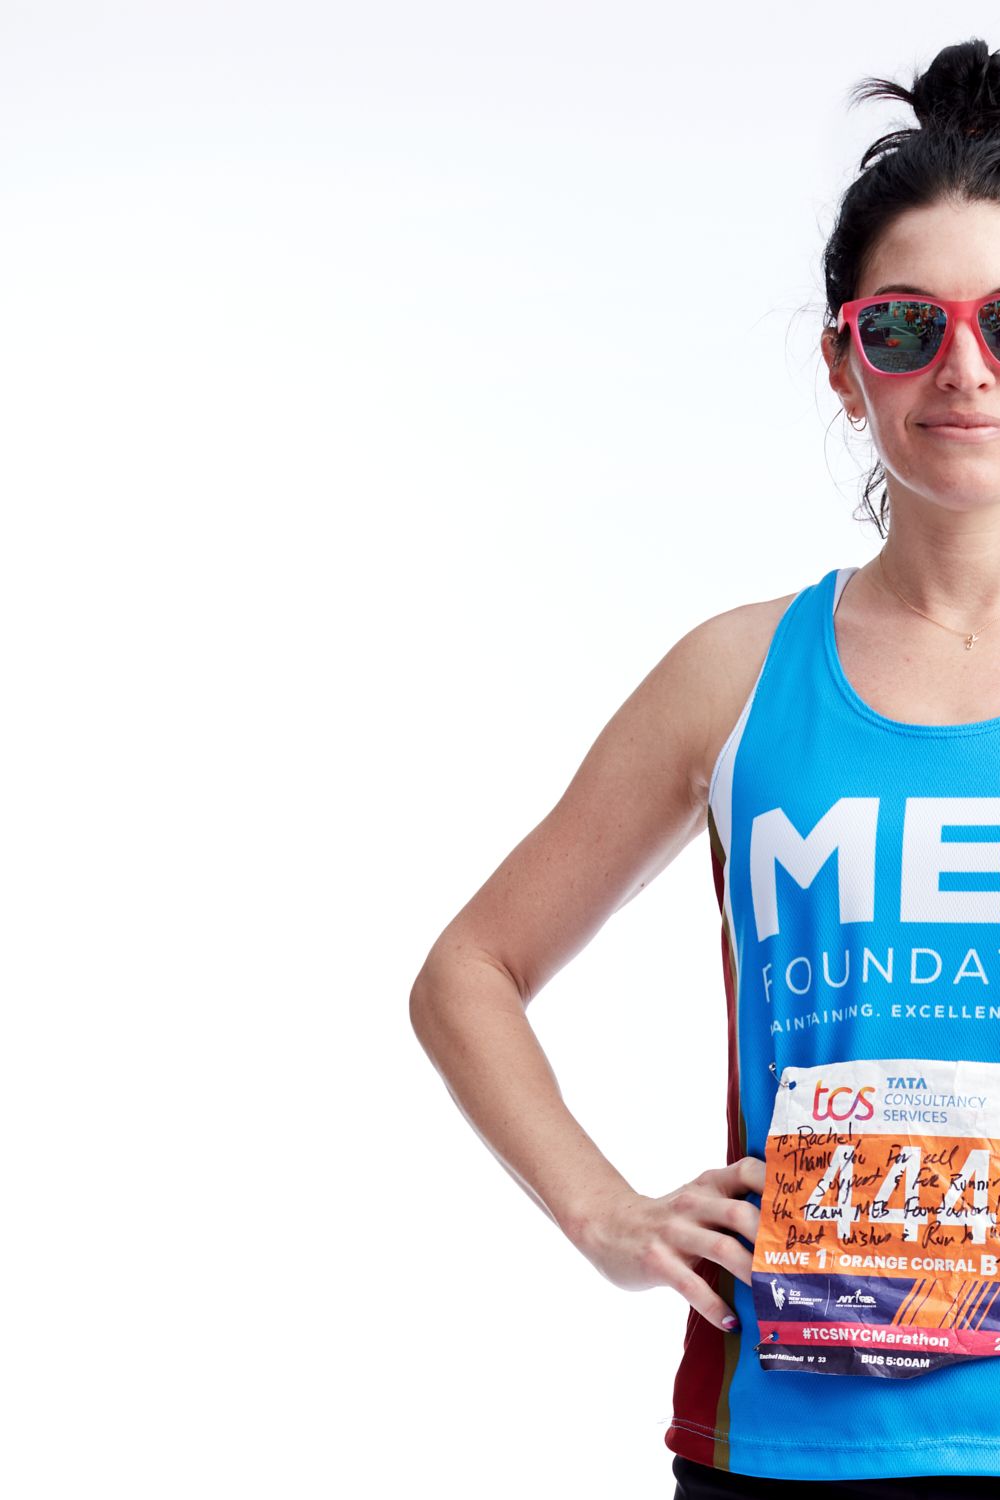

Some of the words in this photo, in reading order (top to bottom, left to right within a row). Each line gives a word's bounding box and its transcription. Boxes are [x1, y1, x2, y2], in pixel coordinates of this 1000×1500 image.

[886, 1077, 928, 1090] TATA
[812, 1079, 876, 1122] tcs
[883, 1093, 987, 1110] CONSULTANCY
[883, 1109, 948, 1124] SERVICES
[784, 1147, 832, 1177] Thank
[923, 1145, 960, 1170] all
[772, 1198, 794, 1223] the
[853, 1200, 890, 1221] MEB
[921, 1220, 955, 1250] Run
[764, 1250, 810, 1266] WAVE
[816, 1247, 828, 1269] 1
[839, 1253, 908, 1271] ORANGE
[910, 1255, 977, 1273] CORRAL
[979, 1253, 999, 1277] B
[802, 1326, 950, 1348] #TCSNYCMarathon
[861, 1354, 886, 1366] BUS
[886, 1356, 930, 1369] 5:00AM
